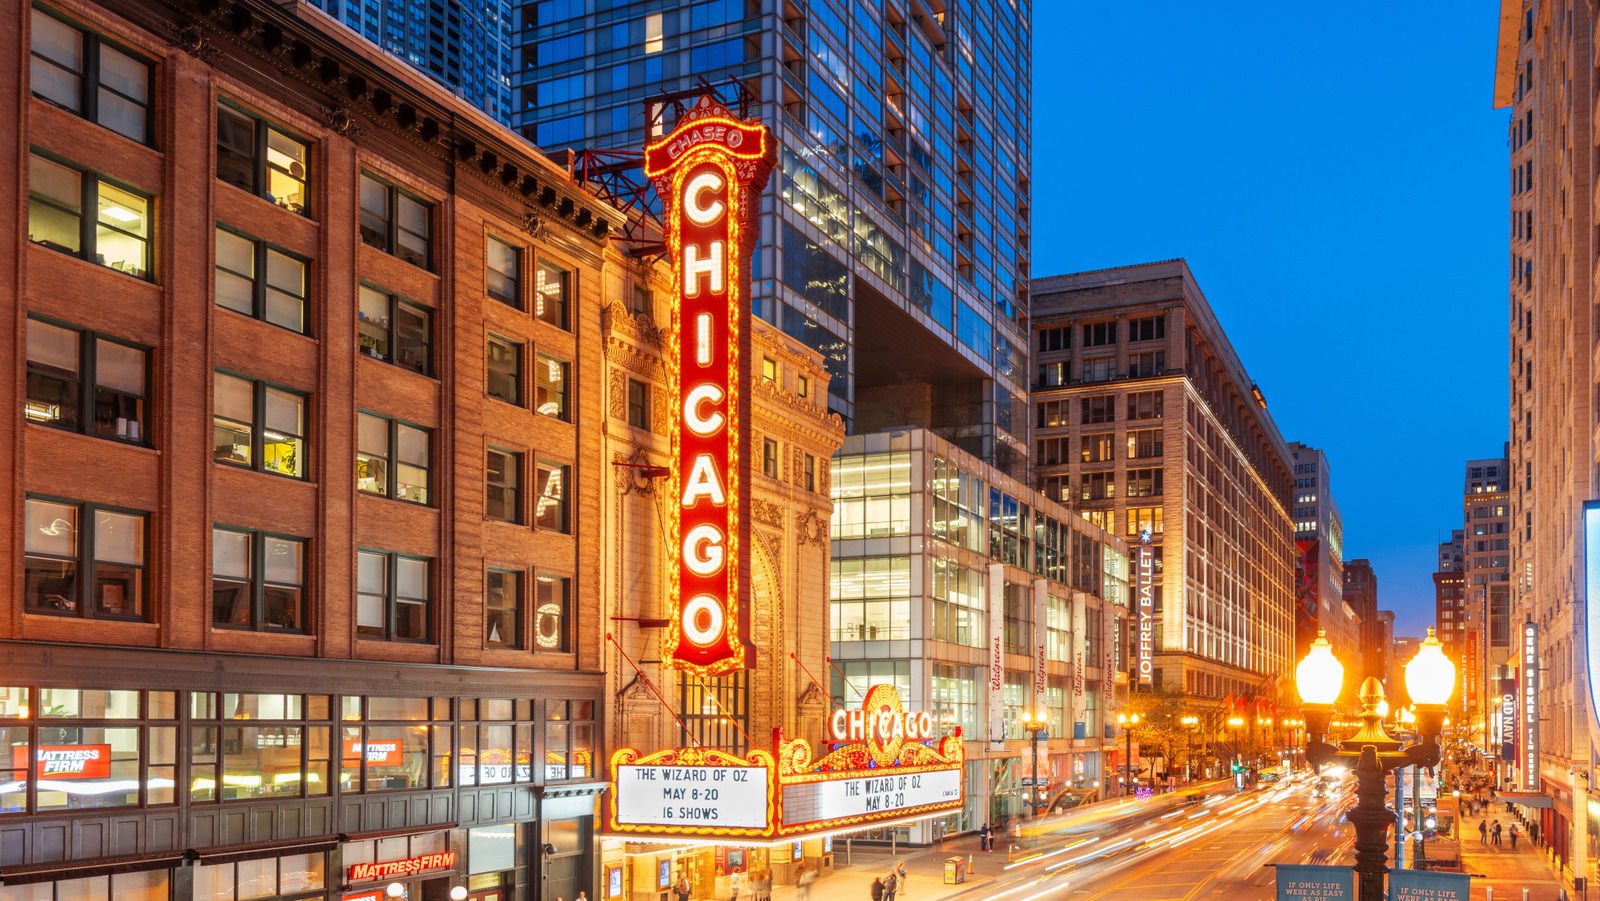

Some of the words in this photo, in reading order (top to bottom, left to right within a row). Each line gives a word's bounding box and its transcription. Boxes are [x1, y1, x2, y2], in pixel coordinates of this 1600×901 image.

[667, 125, 726, 159] CHASE
[682, 172, 727, 647] CHICAGO
[1140, 549, 1152, 607] BALLET
[1140, 611, 1152, 682] JOFFREY
[1525, 628, 1535, 664] GENE
[992, 636, 1003, 692] Walgreens
[1036, 644, 1046, 694] Walgreens
[1075, 651, 1084, 697] Walgreens
[1105, 658, 1114, 700] Walgreens
[1503, 694, 1513, 715] OLD
[1526, 669, 1535, 723] SISKEL
[832, 708, 932, 741] CHICAGO
[1503, 717, 1514, 745] NAVY
[352, 743, 396, 752] MTTRESS
[44, 760, 85, 772] FIRM
[635, 768, 656, 780] THE
[662, 769, 707, 782] WIZARD
[713, 769, 727, 782] OF
[733, 770, 748, 782] OZ
[663, 788, 686, 800] MAY
[691, 788, 719, 800] 8-20
[845, 781, 860, 796] THE
[865, 778, 894, 794] WIZARD
[898, 776, 907, 791] OF
[912, 775, 921, 789] OZ
[866, 796, 881, 811] MAY
[885, 793, 904, 808] 8-20
[663, 807, 673, 818] 16
[679, 807, 718, 820] SHOWS
[1411, 888, 1435, 896] ONLY
[1437, 890, 1456, 898] LIFE
